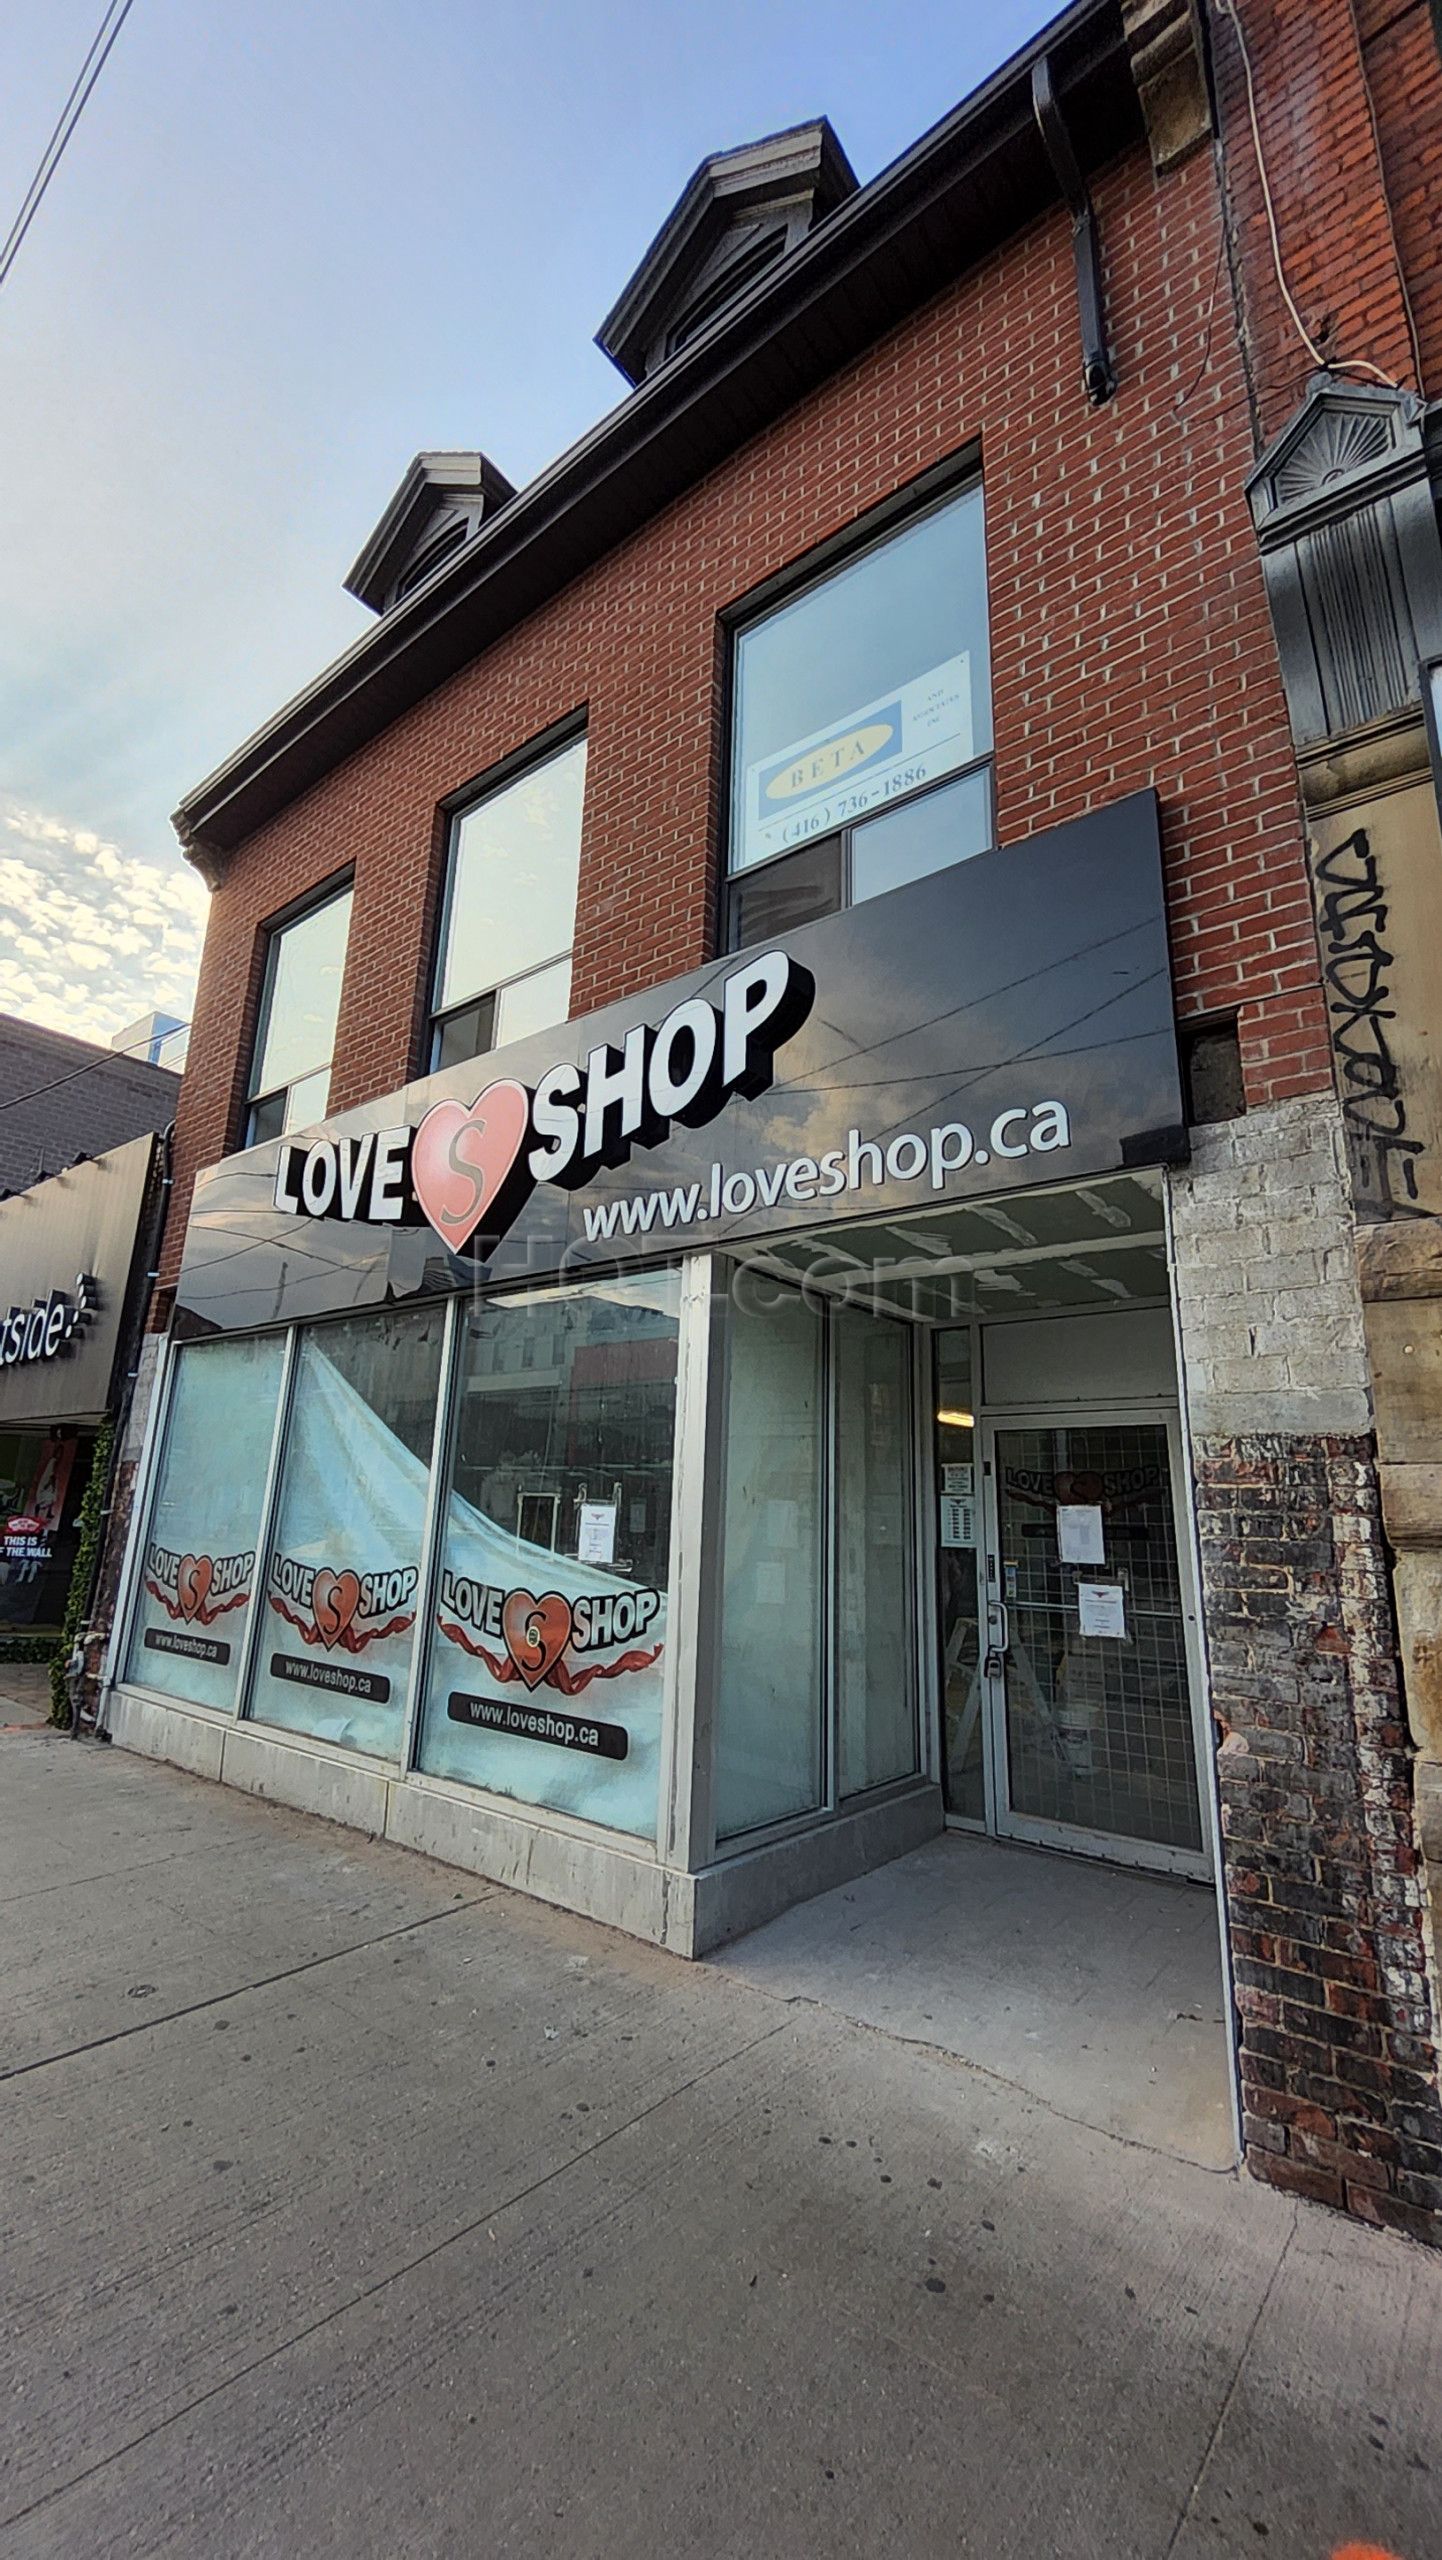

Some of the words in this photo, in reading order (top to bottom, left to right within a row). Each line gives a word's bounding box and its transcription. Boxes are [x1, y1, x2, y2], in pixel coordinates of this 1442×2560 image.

[790, 739, 866, 789] BETA
[274, 1125, 411, 1221] LOVE
[440, 1119, 487, 1226] S
[528, 949, 792, 1184] SHOP
[582, 1099, 1073, 1243] www.loveshop.ca
[1004, 1467, 1055, 1499] LOVE
[1102, 1465, 1161, 1499] SHOP
[4, 1535, 27, 1546] THIS
[26, 1536, 38, 1546] IS
[6, 1546, 27, 1558] THE
[26, 1547, 53, 1558] WALL
[148, 1542, 182, 1590] LOVE
[210, 1550, 256, 1597] SHOP
[272, 1553, 317, 1609] LOVE
[357, 1565, 420, 1619] SHOP
[442, 1569, 506, 1640] LOVE
[570, 1588, 661, 1653] SHOP
[154, 1633, 218, 1659] www.loveshop.ca
[285, 1659, 372, 1695] www.loveshop.ca
[469, 1701, 600, 1747] www.loveshop.ca
